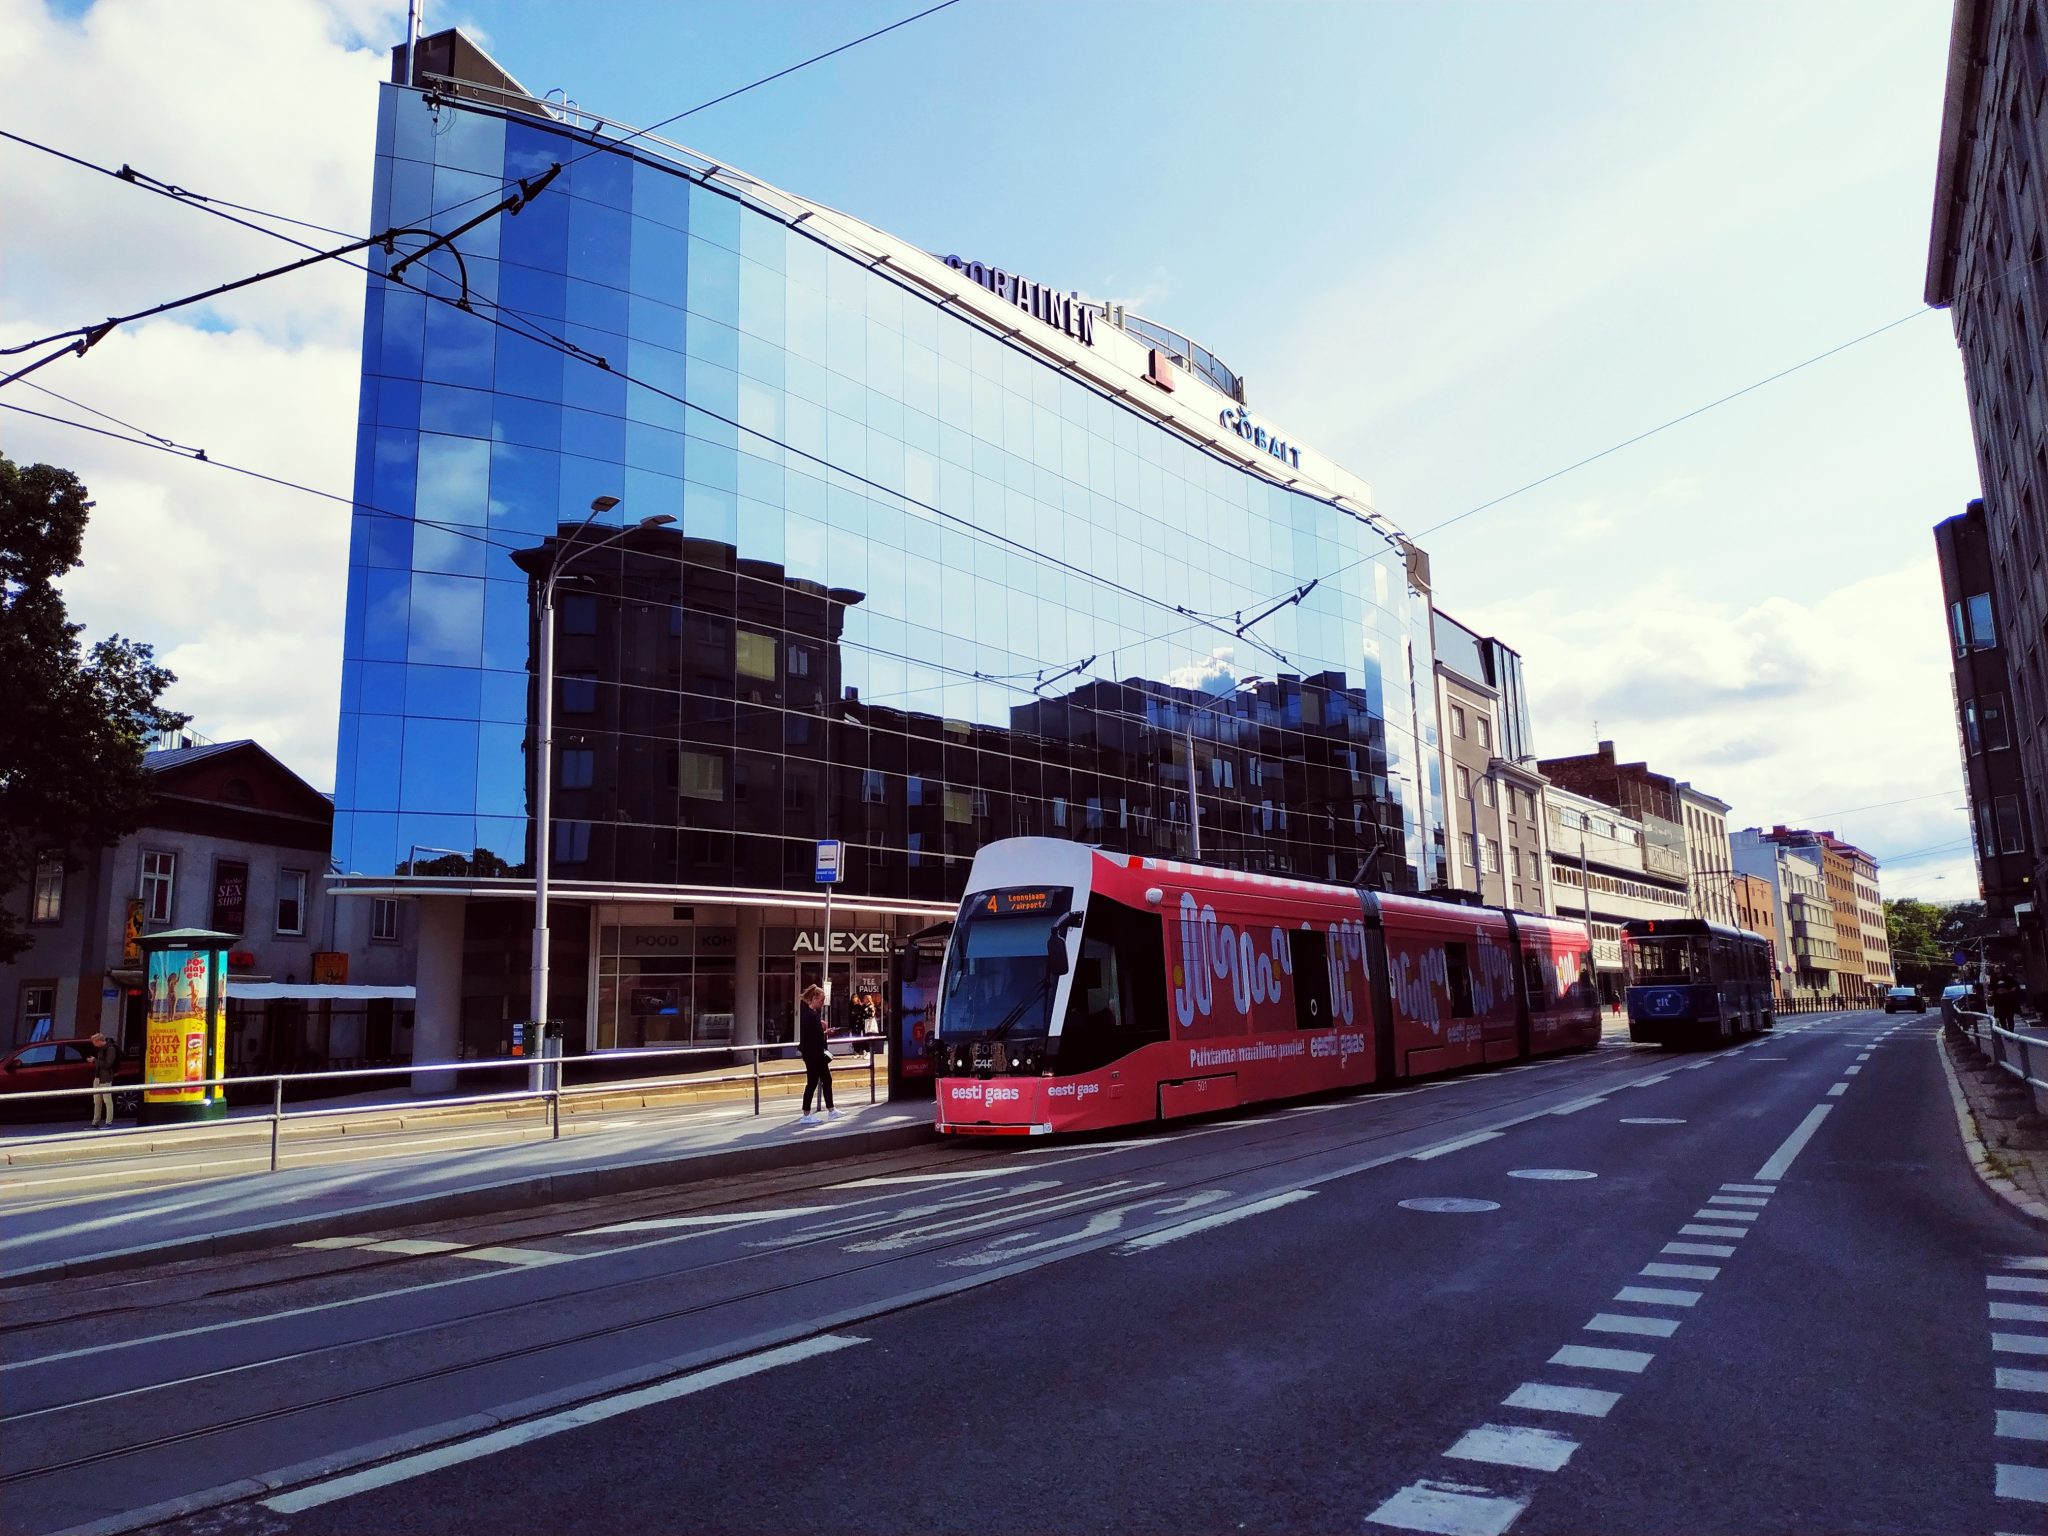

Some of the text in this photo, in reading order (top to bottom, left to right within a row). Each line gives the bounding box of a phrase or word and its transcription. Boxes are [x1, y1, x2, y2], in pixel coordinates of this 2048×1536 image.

[218, 884, 243, 897] SEX
[217, 896, 242, 907] SHOP
[987, 895, 998, 913] 4
[1648, 920, 1655, 933] 3
[635, 935, 679, 947] FOOD
[702, 935, 736, 947] KOH
[862, 978, 875, 986] TEE
[149, 1044, 180, 1055] SONY
[1190, 1048, 1236, 1068] Puhtama
[1311, 1029, 1337, 1058] eesti
[1340, 1032, 1365, 1070] gaas
[952, 1084, 1019, 1107] eesti gaas
[1048, 1083, 1099, 1100] eesti gaas
